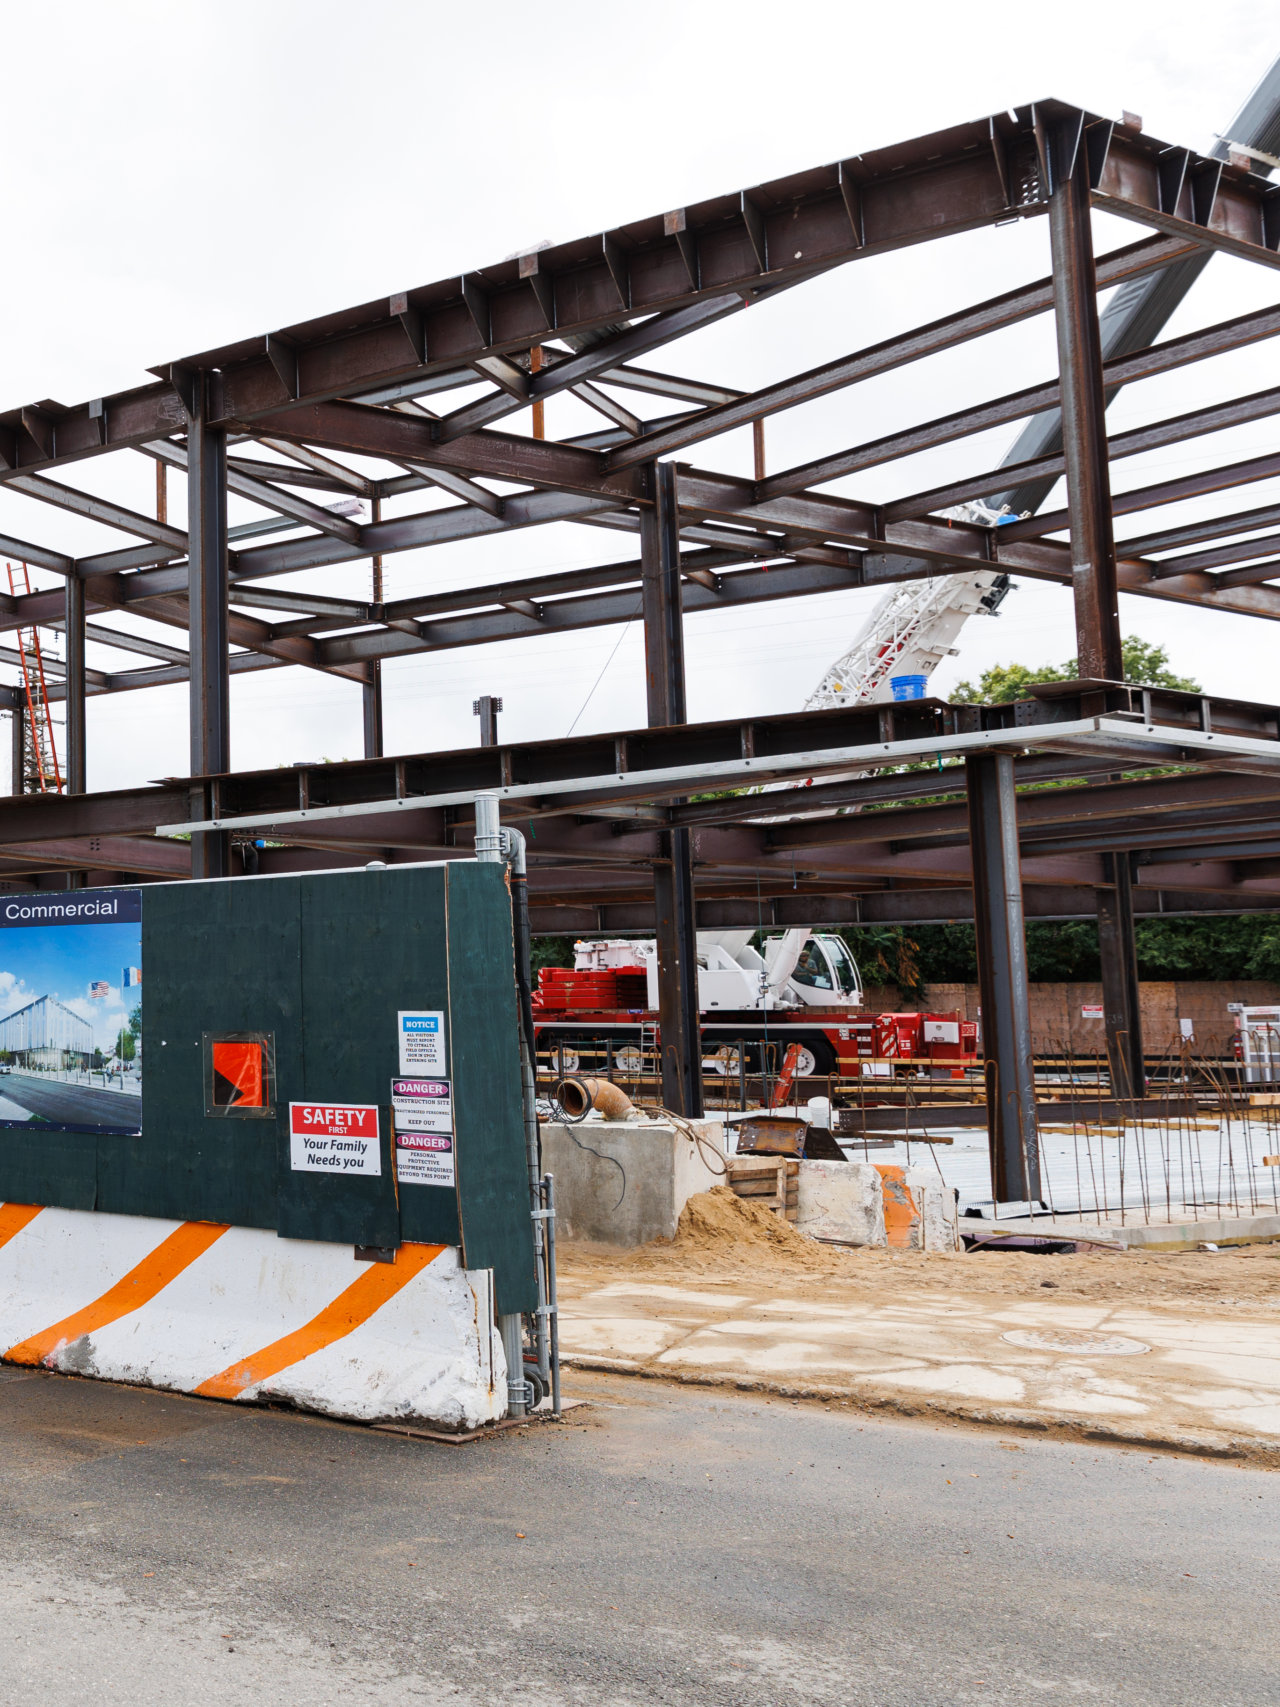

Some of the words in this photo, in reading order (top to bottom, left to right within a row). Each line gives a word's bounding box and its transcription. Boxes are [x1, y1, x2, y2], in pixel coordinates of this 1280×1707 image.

[6, 899, 118, 919] Commercial
[399, 1083, 443, 1094] DANGER
[303, 1108, 366, 1126] SAFETY
[328, 1126, 347, 1134] FIRST
[304, 1138, 328, 1149] Your
[330, 1140, 367, 1155] Family
[402, 1136, 445, 1148] DANGER
[307, 1154, 341, 1166] Needs
[343, 1158, 364, 1169] you
